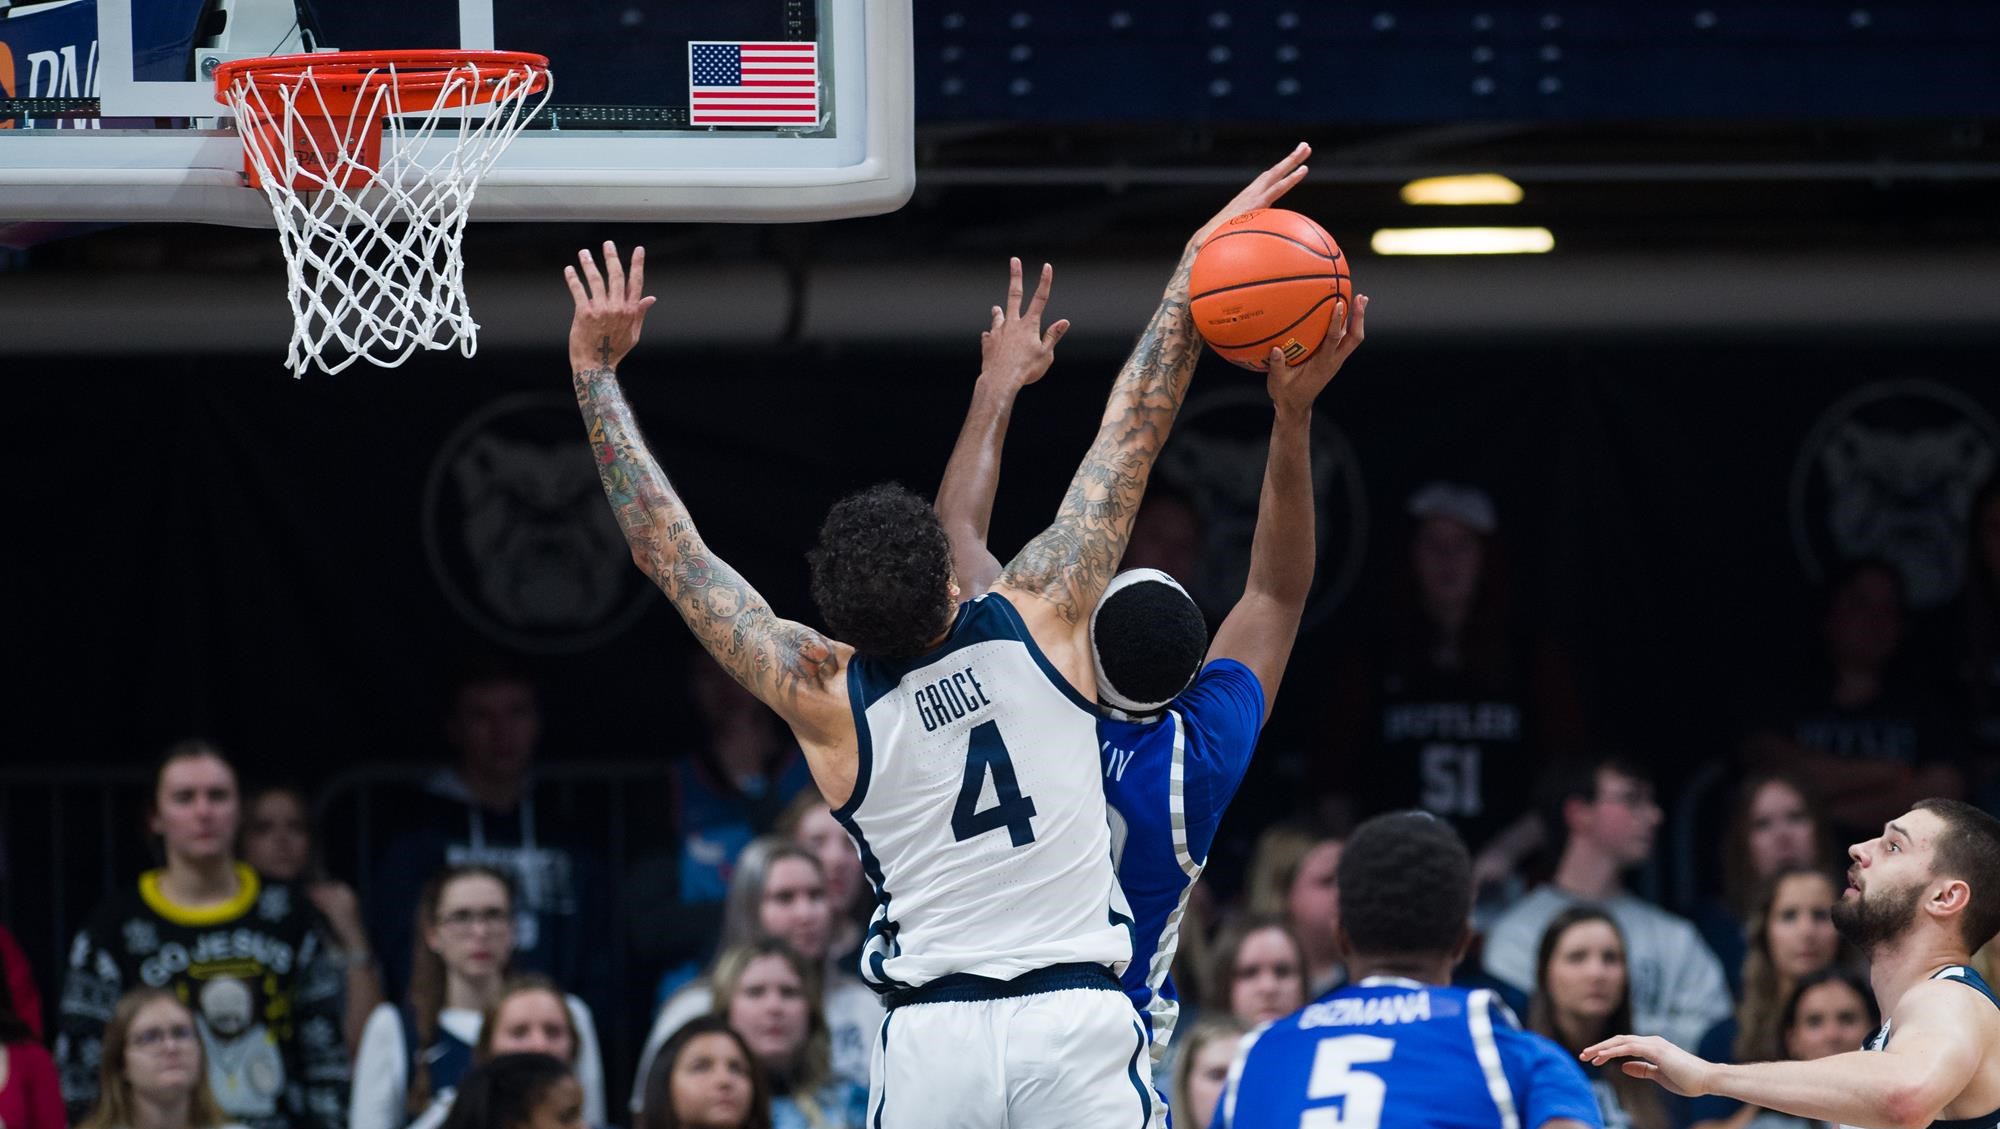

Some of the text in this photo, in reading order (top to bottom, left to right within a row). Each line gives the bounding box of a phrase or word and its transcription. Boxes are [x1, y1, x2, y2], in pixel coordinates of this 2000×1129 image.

[914, 666, 991, 733] GROCE
[950, 718, 1038, 849] 4
[1419, 741, 1482, 816] 51
[1298, 1033, 1396, 1129] 5
